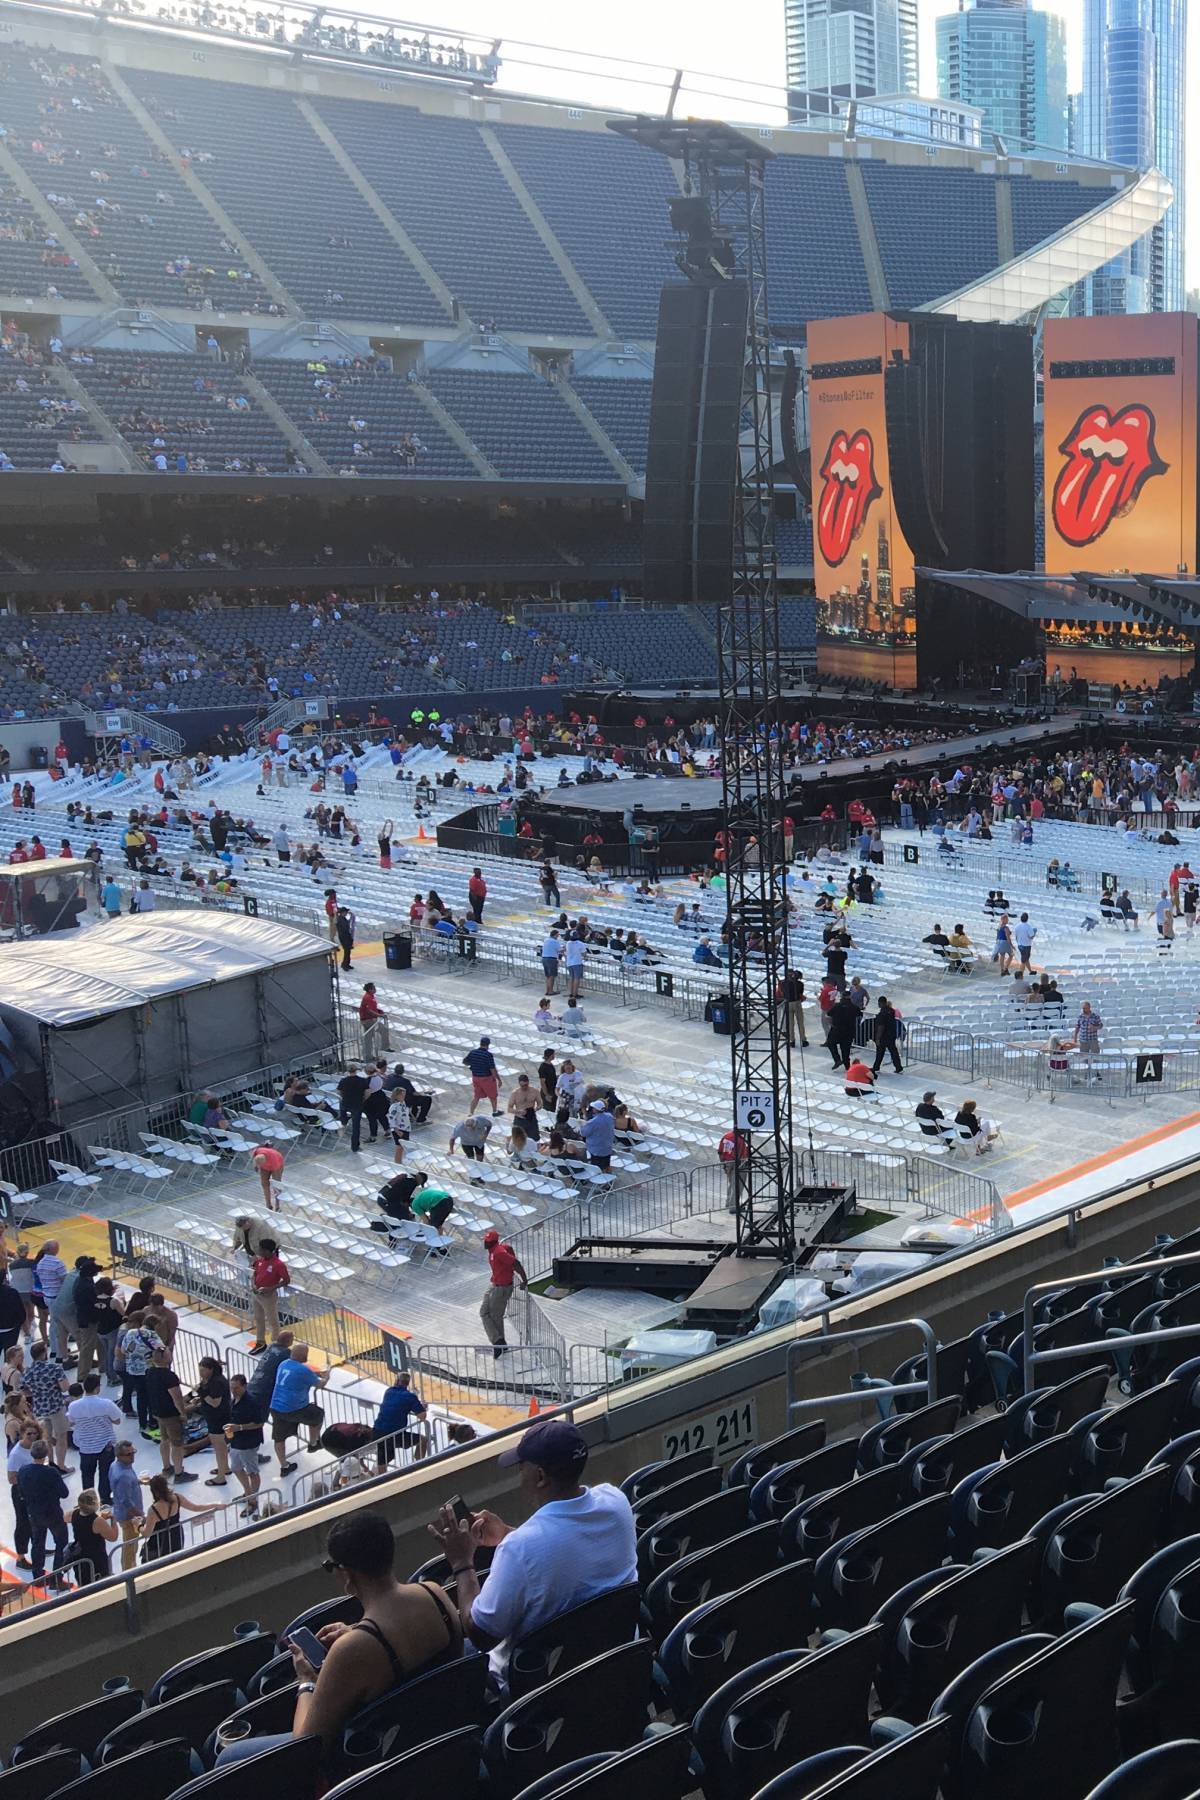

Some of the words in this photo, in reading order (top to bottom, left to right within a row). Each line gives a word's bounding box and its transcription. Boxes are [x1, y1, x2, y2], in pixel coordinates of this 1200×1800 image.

[429, 791, 434, 801] D
[908, 848, 915, 859] B
[247, 901, 254, 914] C
[464, 940, 471, 953] F
[661, 976, 668, 991] F
[1143, 1059, 1156, 1078] A
[741, 1096, 760, 1106] PIT
[764, 1096, 771, 1106] 2
[116, 1230, 127, 1254] H
[390, 1342, 402, 1369] H
[667, 1425, 704, 1459] 212
[715, 1404, 752, 1446] 211
